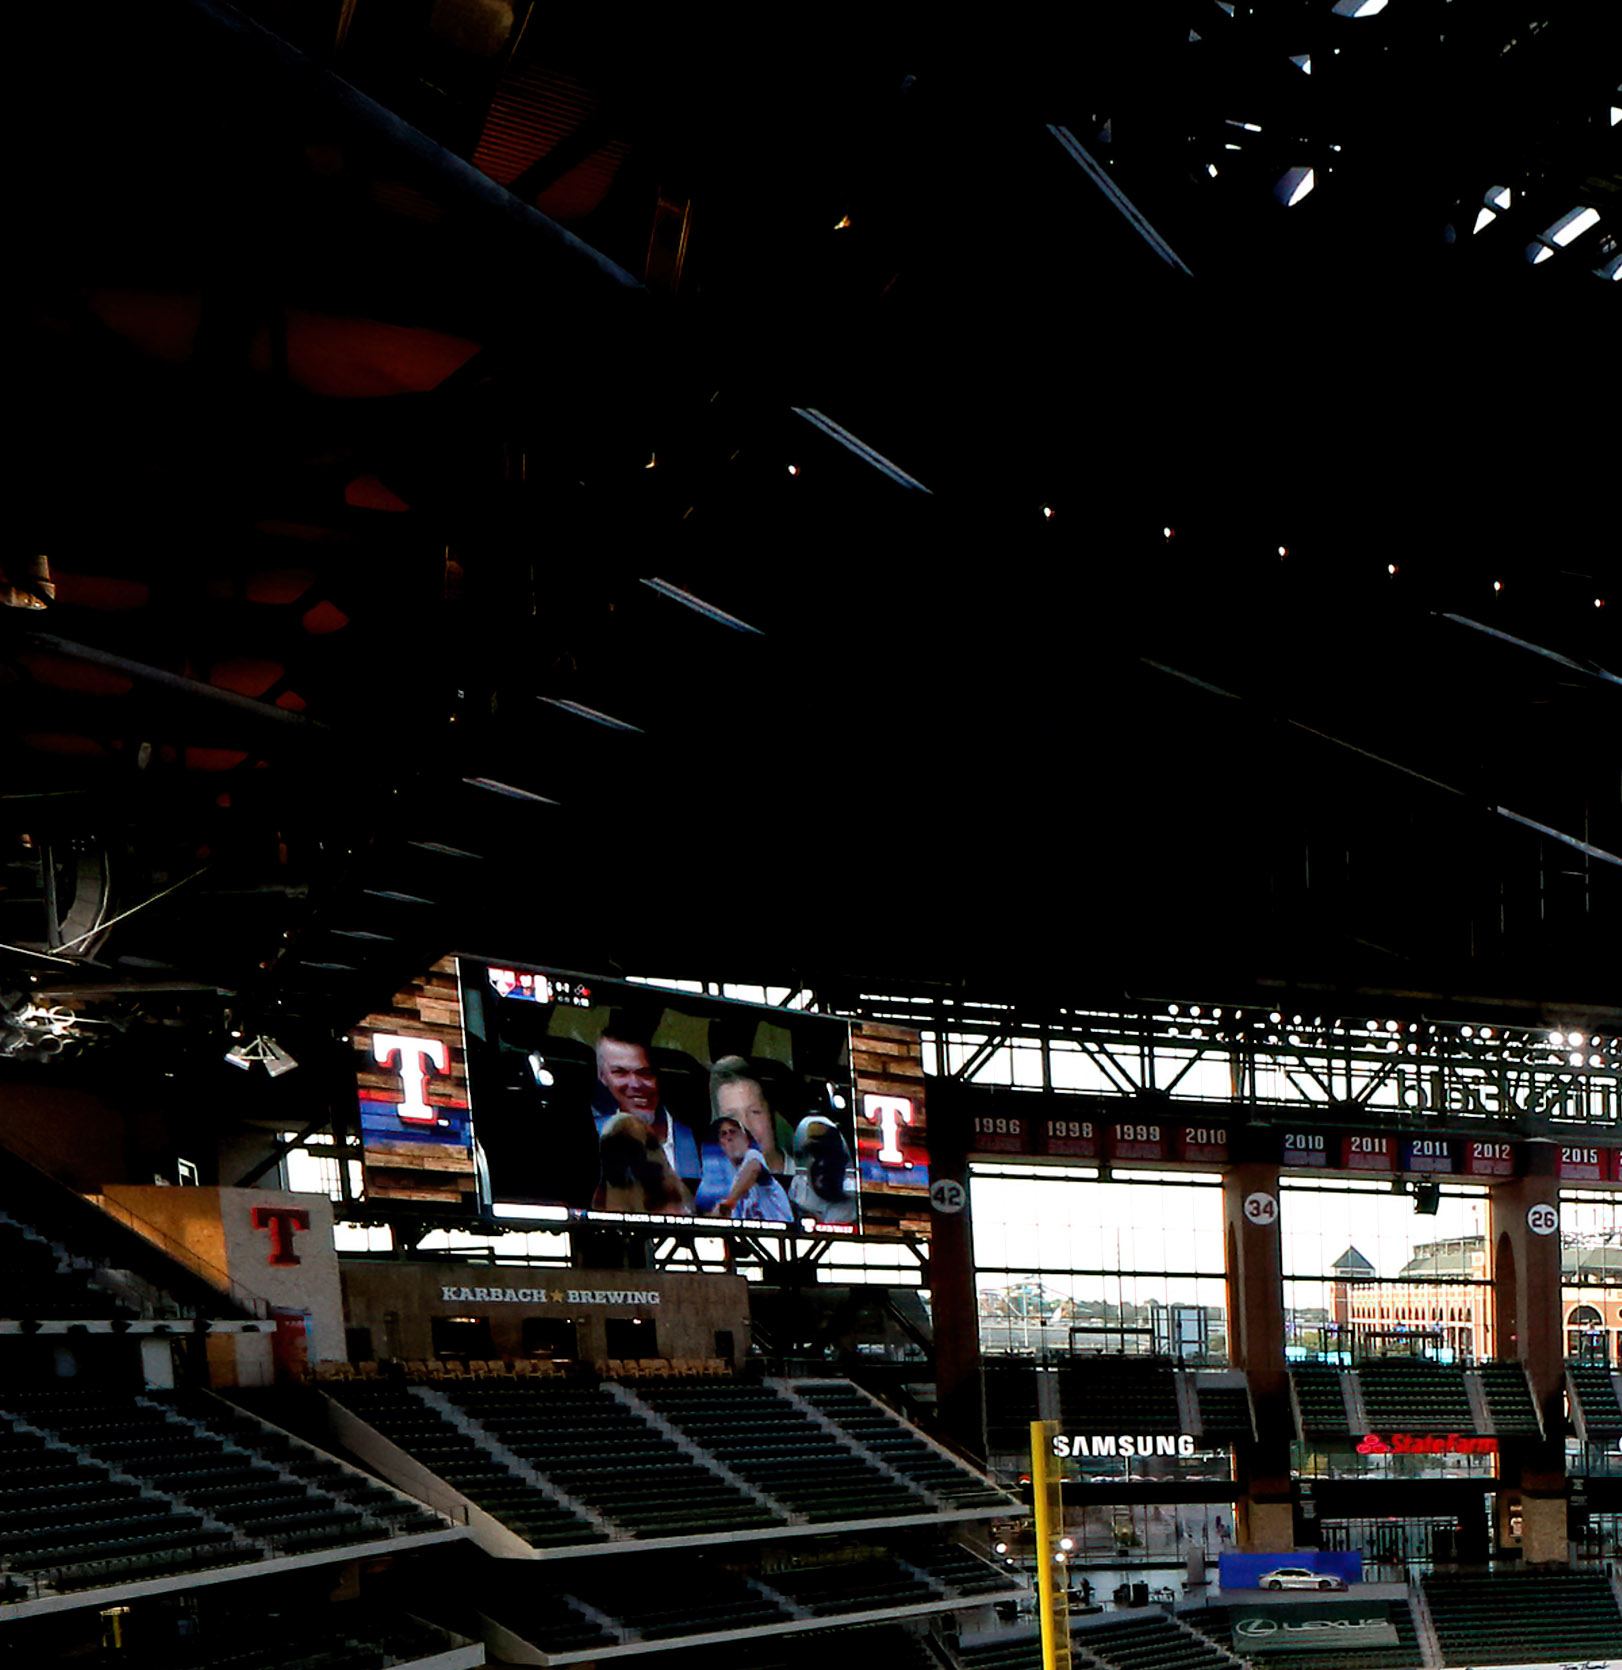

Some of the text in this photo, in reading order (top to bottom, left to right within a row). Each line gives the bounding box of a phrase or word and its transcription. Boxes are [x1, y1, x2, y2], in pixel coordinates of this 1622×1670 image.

[372, 1032, 451, 1125] T
[863, 1093, 915, 1169] T
[974, 1117, 1021, 1135] 1996
[1047, 1120, 1093, 1139] 1998
[1115, 1124, 1160, 1142] 1999
[1185, 1128, 1226, 1145] 2010
[1284, 1133, 1324, 1150] 2010
[1350, 1136, 1388, 1154] 2011
[1412, 1140, 1448, 1157] 2011
[1473, 1143, 1511, 1160] 2012
[1561, 1147, 1599, 1164] 2015
[933, 1184, 962, 1207] 42
[1248, 1200, 1275, 1219] 34
[1531, 1210, 1556, 1229] 26
[251, 1205, 310, 1267] T
[442, 1285, 661, 1306] KARBACH BREWING
[1052, 1434, 1195, 1458] SAMSUNG
[1282, 1617, 1389, 1632] LEXUS
